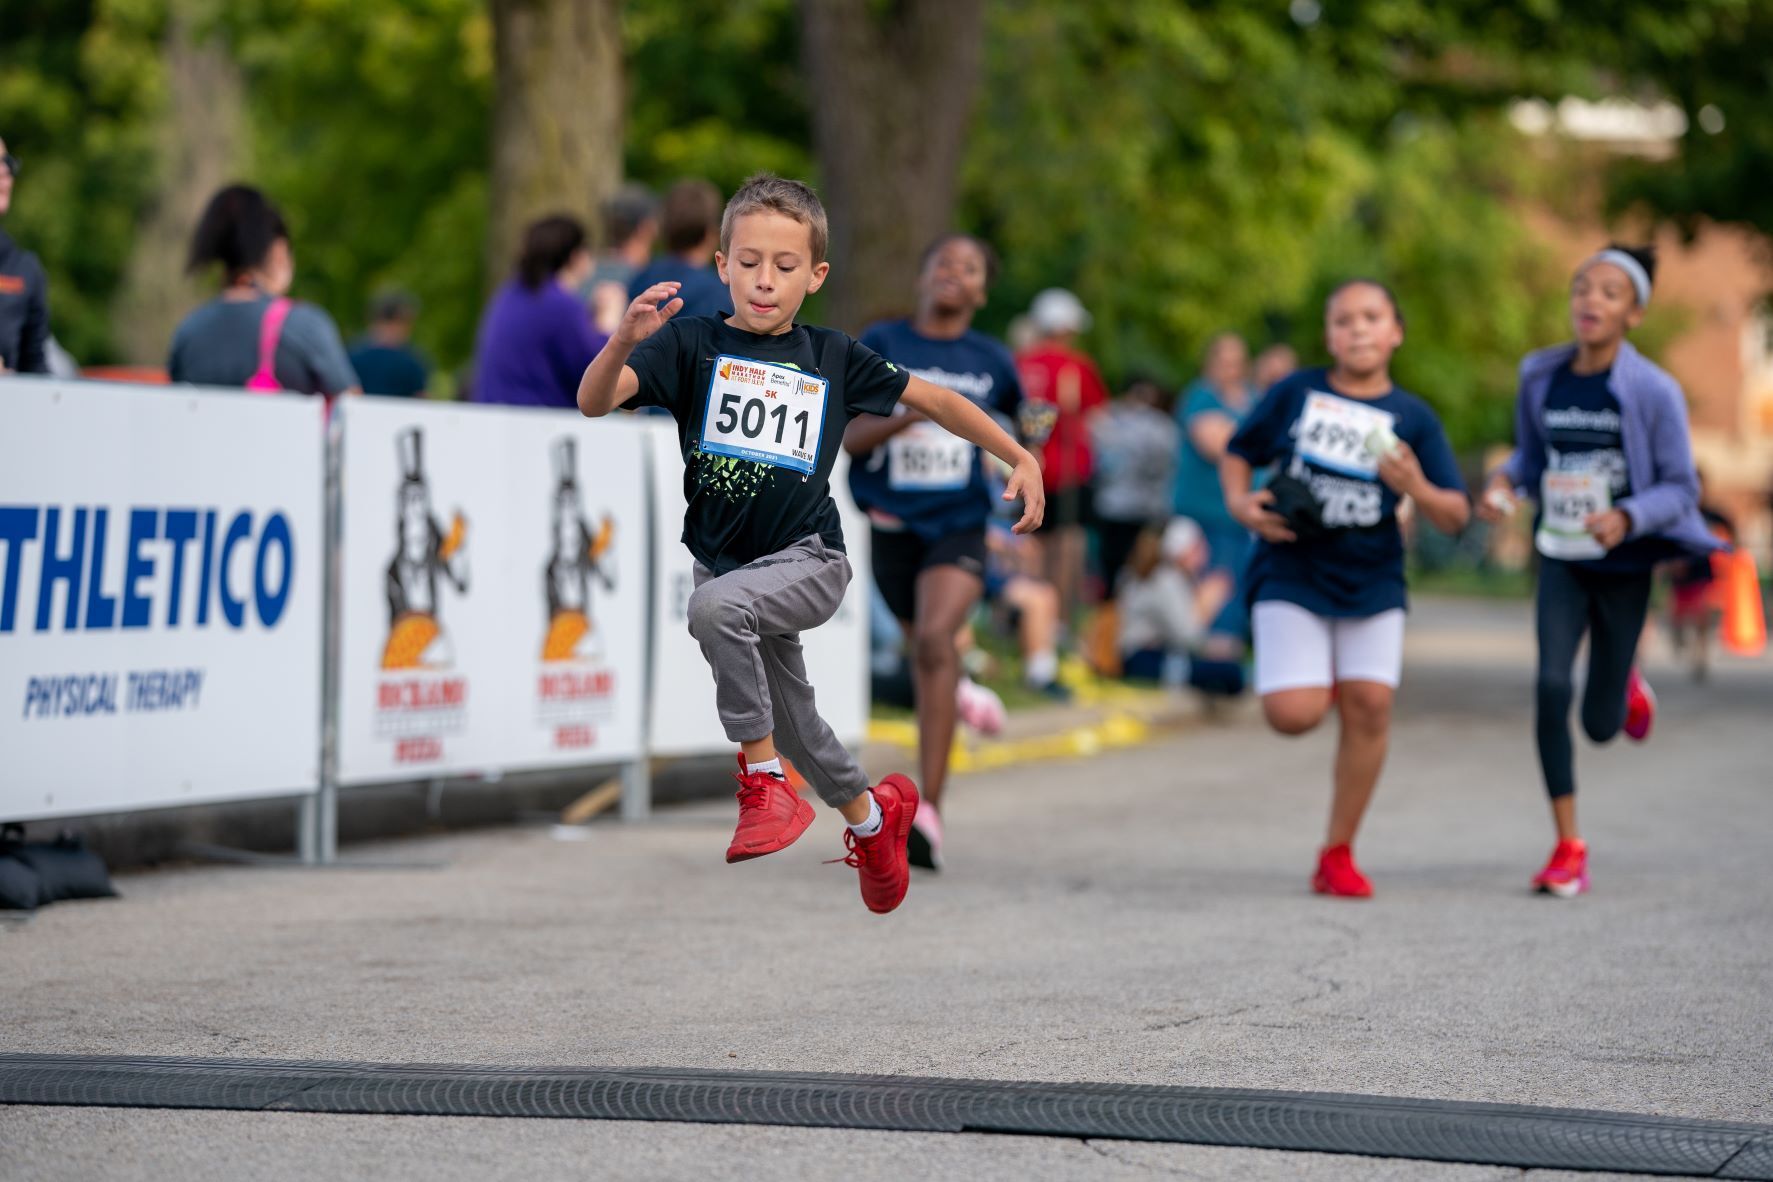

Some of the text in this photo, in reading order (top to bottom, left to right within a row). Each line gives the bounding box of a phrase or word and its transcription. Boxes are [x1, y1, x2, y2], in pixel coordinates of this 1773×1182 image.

[732, 364, 766, 376] INDY HALF
[803, 384, 819, 393] KIDS
[764, 389, 778, 399] 5K
[715, 393, 809, 449] 5011
[741, 449, 765, 458] OCTOBER
[792, 449, 807, 459] WAVE
[22, 667, 206, 719] PHYSICAL THERAPY
